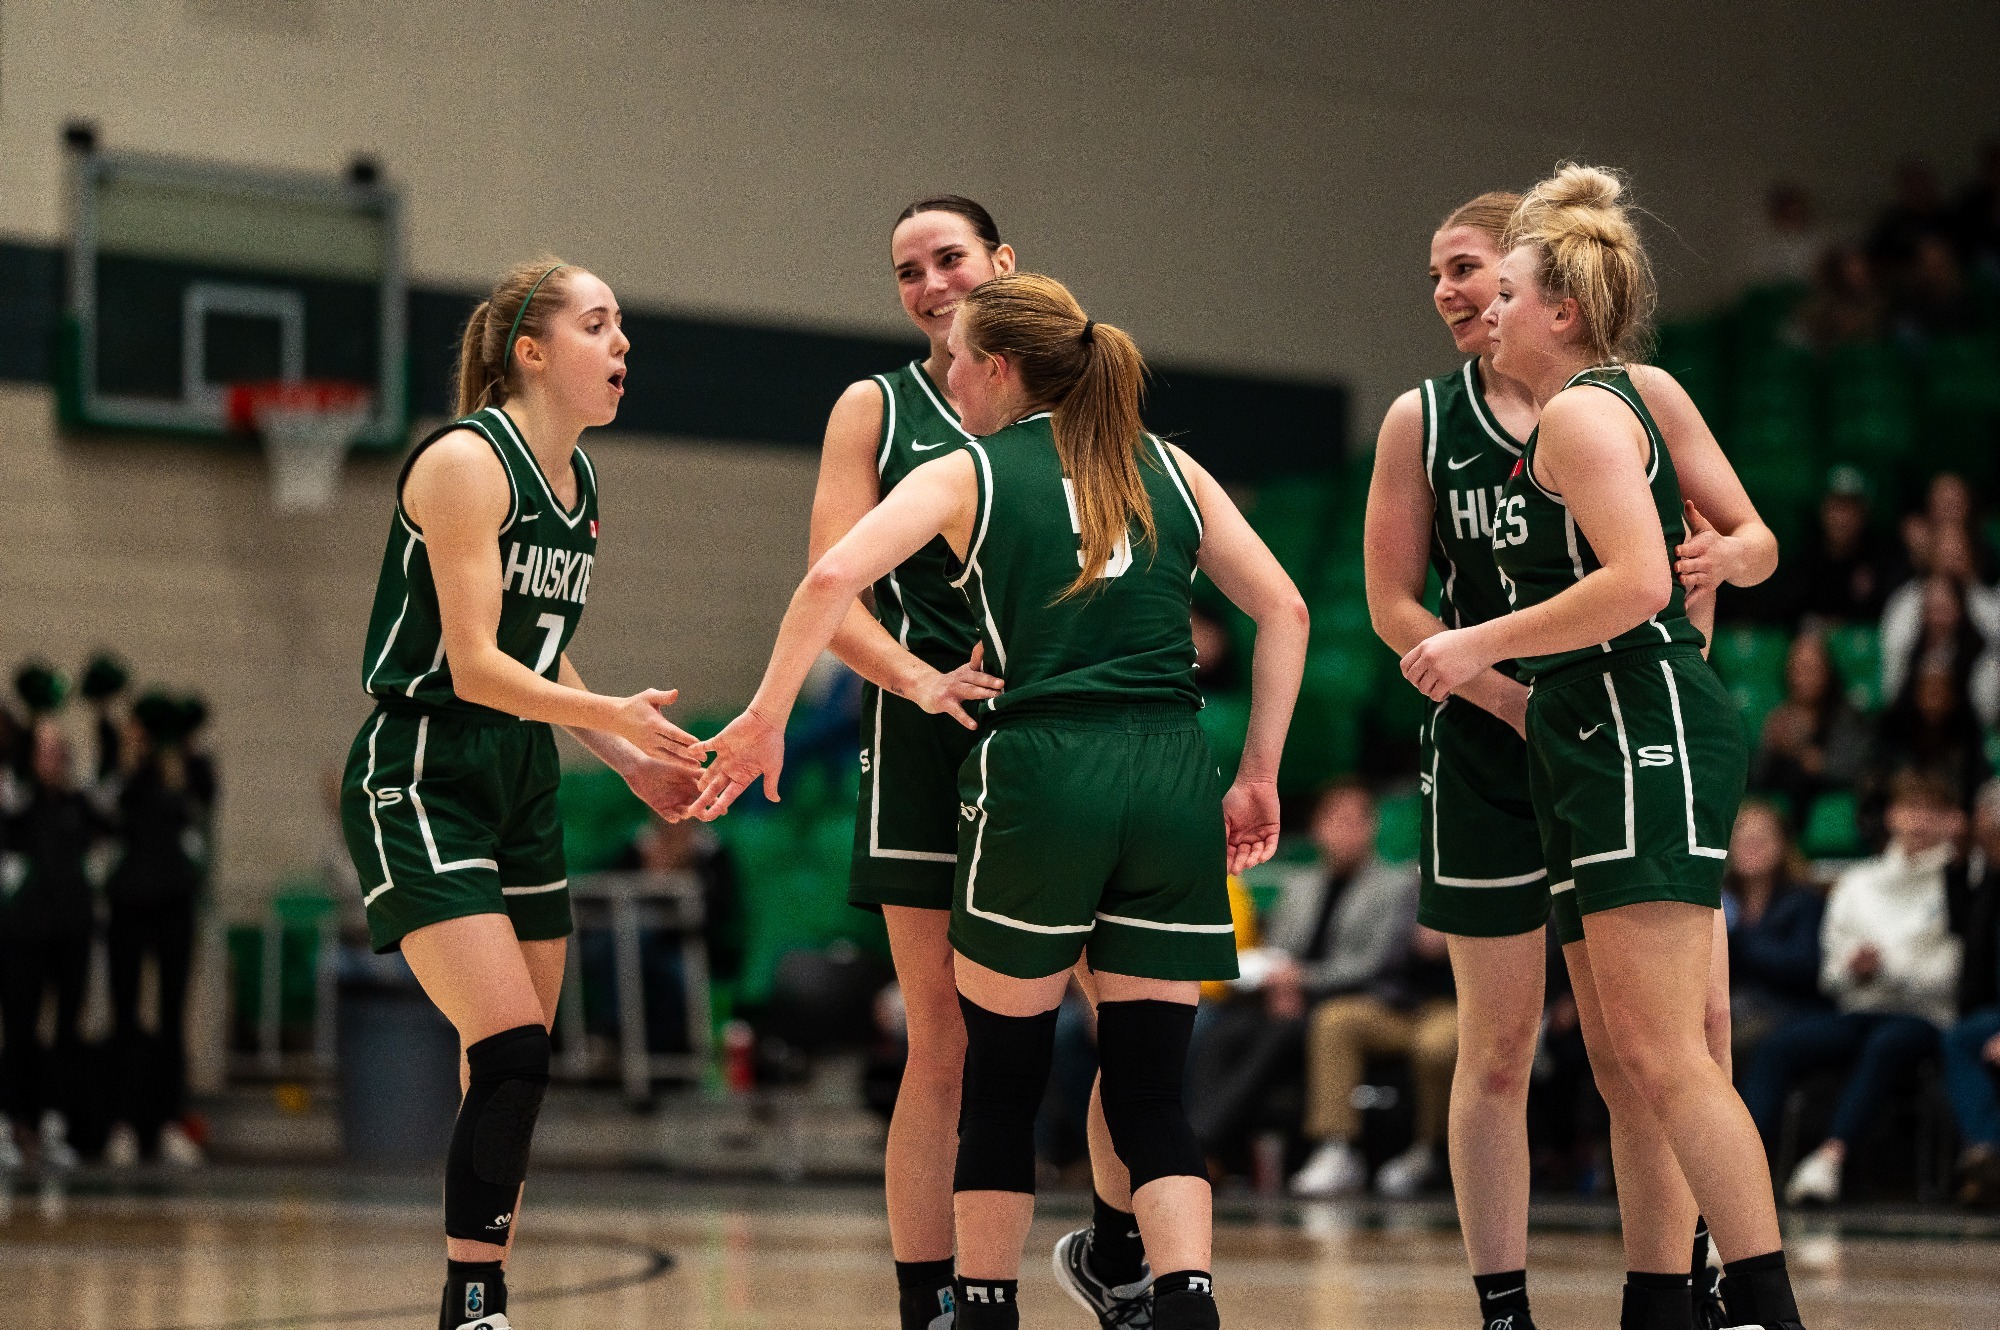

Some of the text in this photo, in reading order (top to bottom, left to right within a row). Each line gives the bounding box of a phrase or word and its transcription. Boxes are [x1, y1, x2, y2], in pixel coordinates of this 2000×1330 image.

[534, 612, 566, 676] 7
[1637, 744, 1675, 768] S
[376, 787, 404, 809] S
